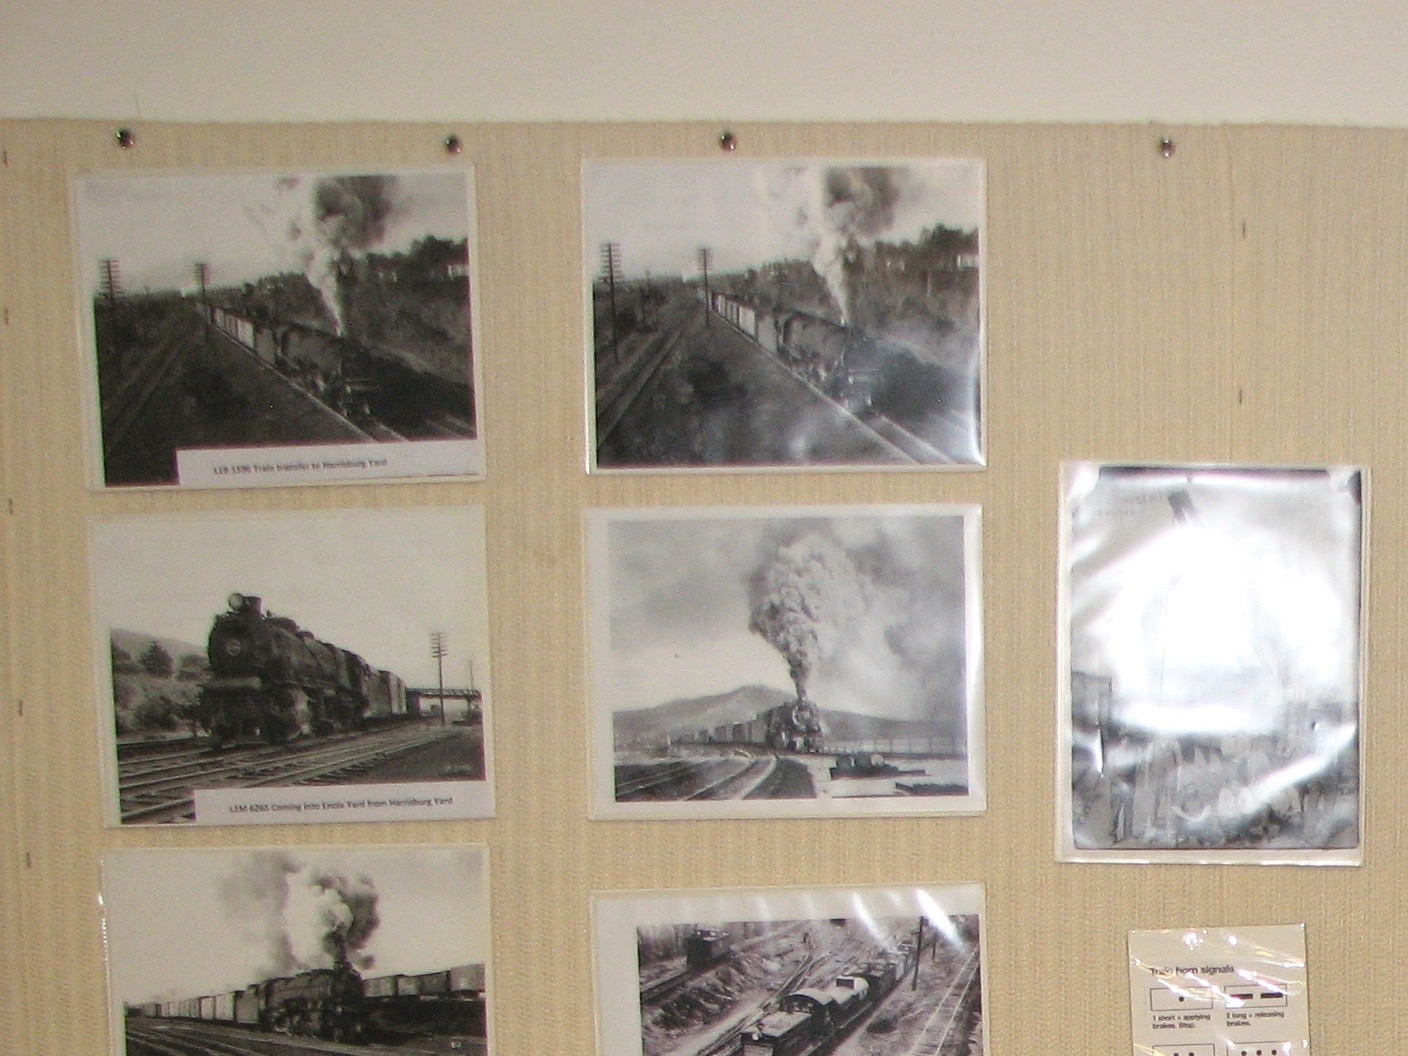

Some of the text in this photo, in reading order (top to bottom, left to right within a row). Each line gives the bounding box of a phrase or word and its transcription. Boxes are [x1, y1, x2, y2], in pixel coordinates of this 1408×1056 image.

[253, 464, 275, 473] Train
[322, 460, 367, 469] Harrisburg
[367, 458, 387, 467] Yard
[271, 803, 302, 812] Coming
[321, 801, 344, 809] Enola
[345, 800, 365, 808] Yard
[367, 799, 388, 807] from
[388, 798, 433, 807] Harrisburg
[433, 797, 453, 805] Yard
[1175, 966, 1198, 974] horn
[1200, 964, 1235, 976] signals
[1183, 1013, 1211, 1021] applying
[1232, 1012, 1247, 1020] long
